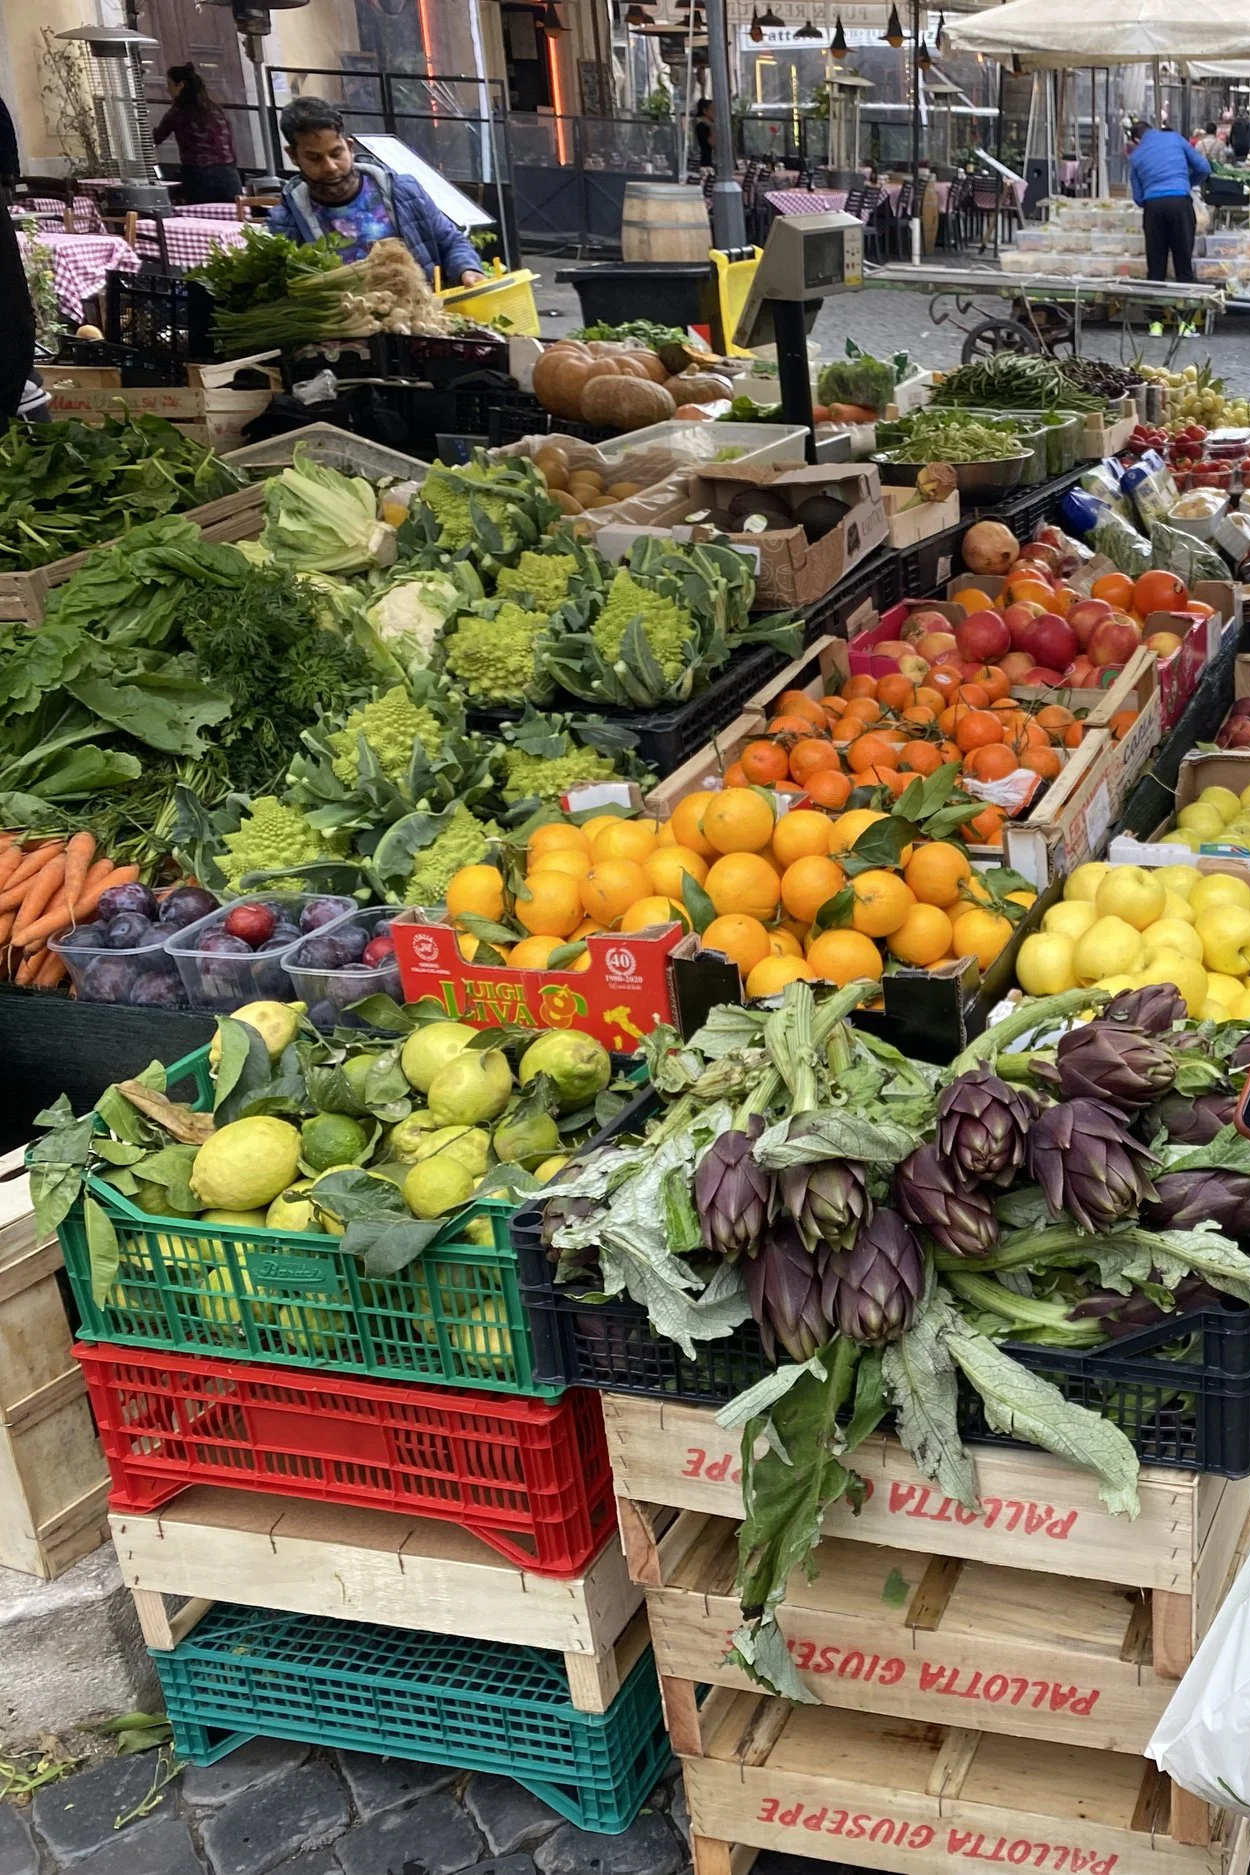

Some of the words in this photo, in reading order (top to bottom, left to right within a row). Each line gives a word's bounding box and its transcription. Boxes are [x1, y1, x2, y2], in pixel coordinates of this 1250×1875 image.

[610, 953, 631, 968] 40
[919, 1661, 1100, 1716] PALLOTTA
[756, 1797, 936, 1850] GIUSEPPE
[946, 1828, 1120, 1875] PALLOTTA
